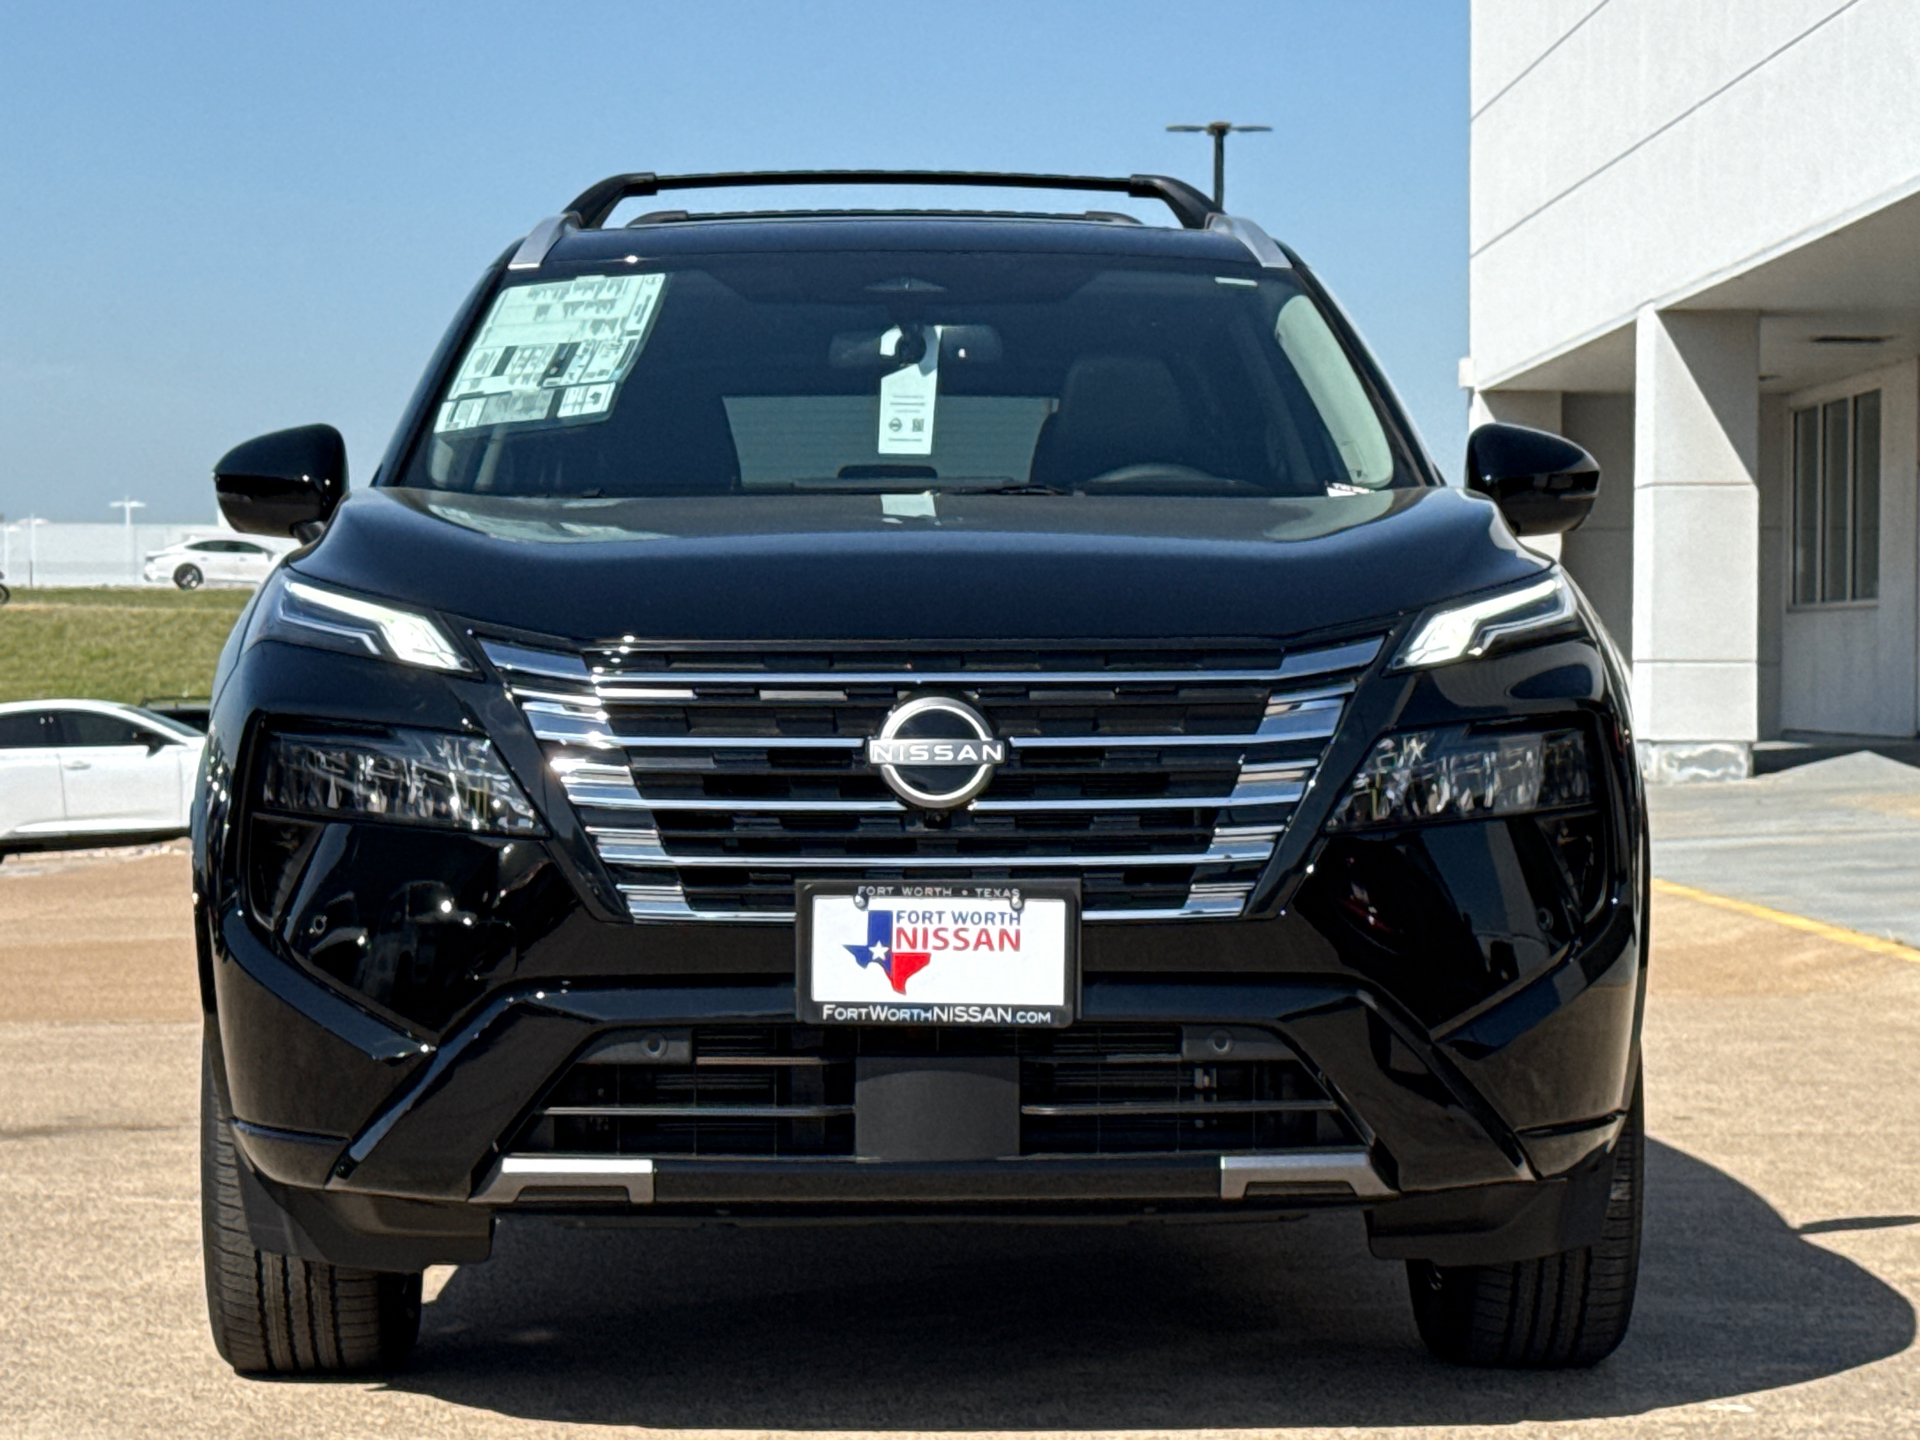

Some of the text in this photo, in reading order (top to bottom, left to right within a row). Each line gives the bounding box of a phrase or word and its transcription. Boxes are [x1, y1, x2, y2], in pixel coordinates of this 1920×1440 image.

[872, 744, 1002, 761] NISSAN
[858, 886, 1021, 899] FORT WORTH TEXAS
[896, 910, 1021, 926] FORT WORTH
[896, 927, 1021, 952] NISSAN
